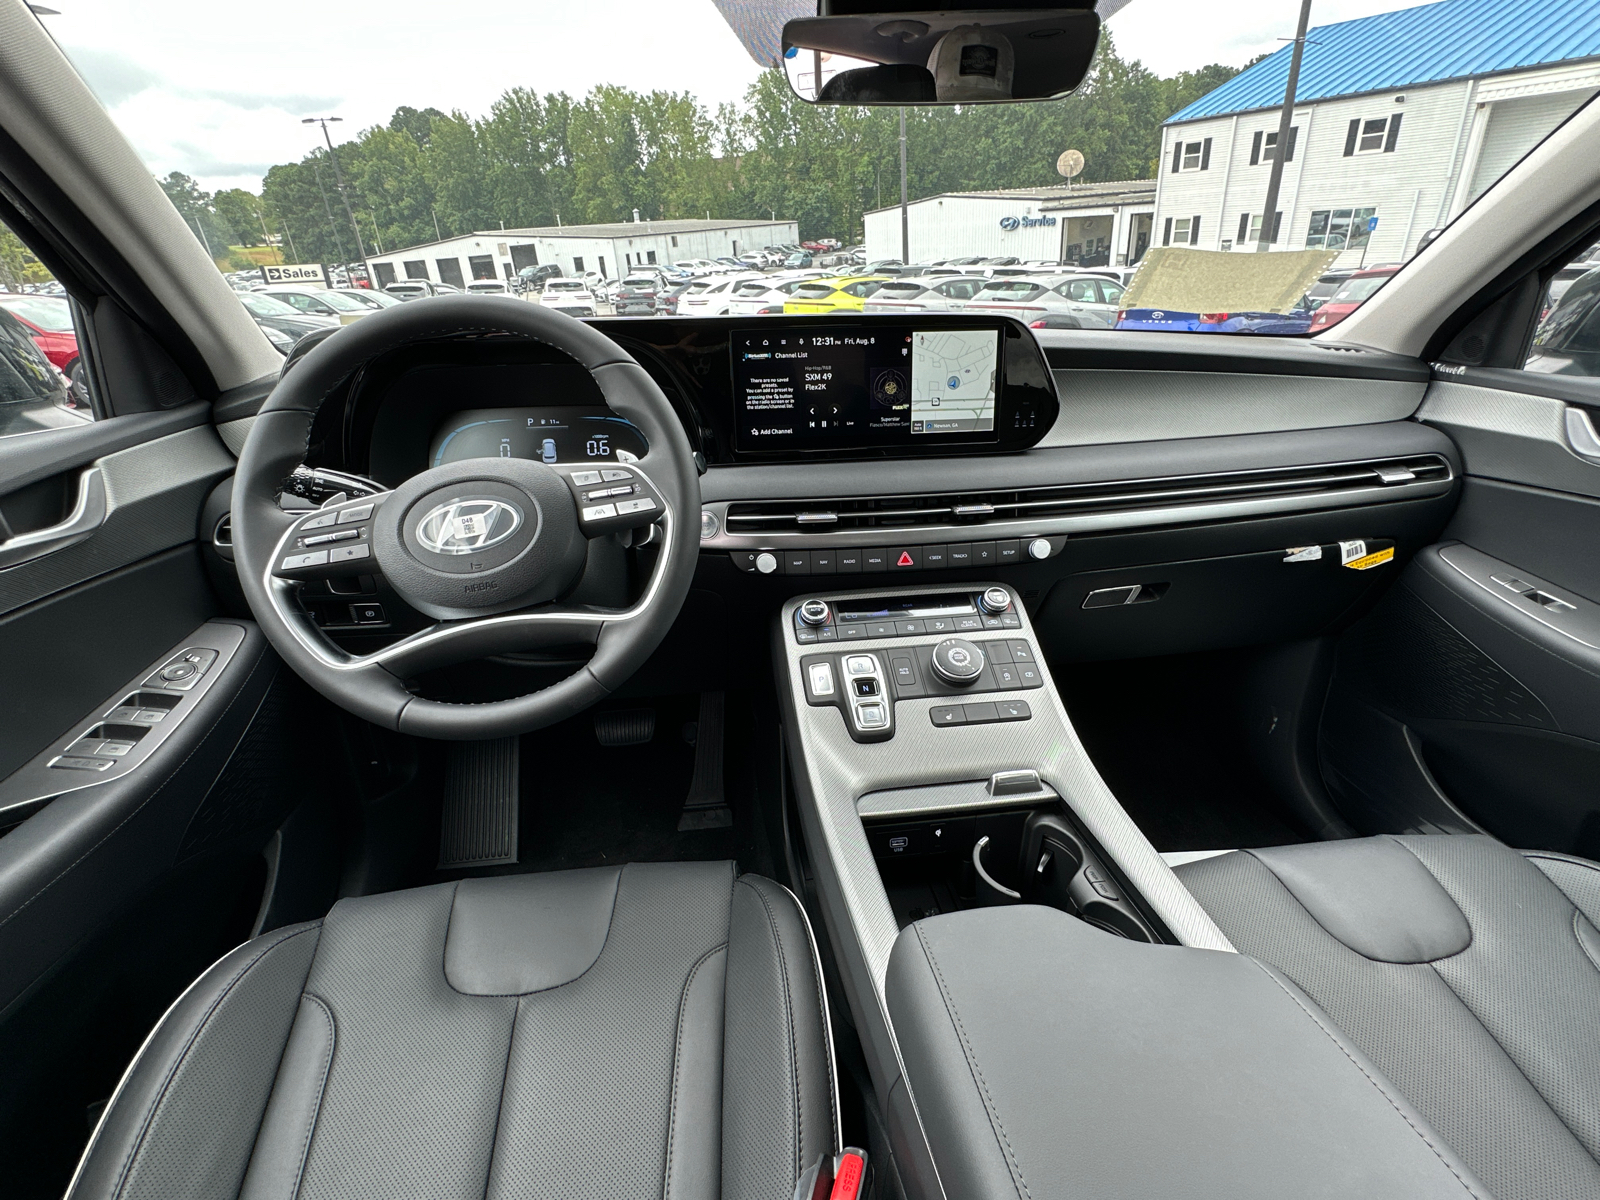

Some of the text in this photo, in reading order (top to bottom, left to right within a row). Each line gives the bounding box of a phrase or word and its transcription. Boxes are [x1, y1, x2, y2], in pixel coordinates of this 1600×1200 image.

[1021, 215, 1056, 228] Service
[282, 268, 318, 279] Sales
[812, 337, 834, 346] 12:31
[856, 338, 869, 346] Aug.
[805, 373, 821, 381] SXM
[527, 418, 534, 426] P
[587, 440, 610, 456] 0.6
[464, 581, 498, 594] AIRBAG
